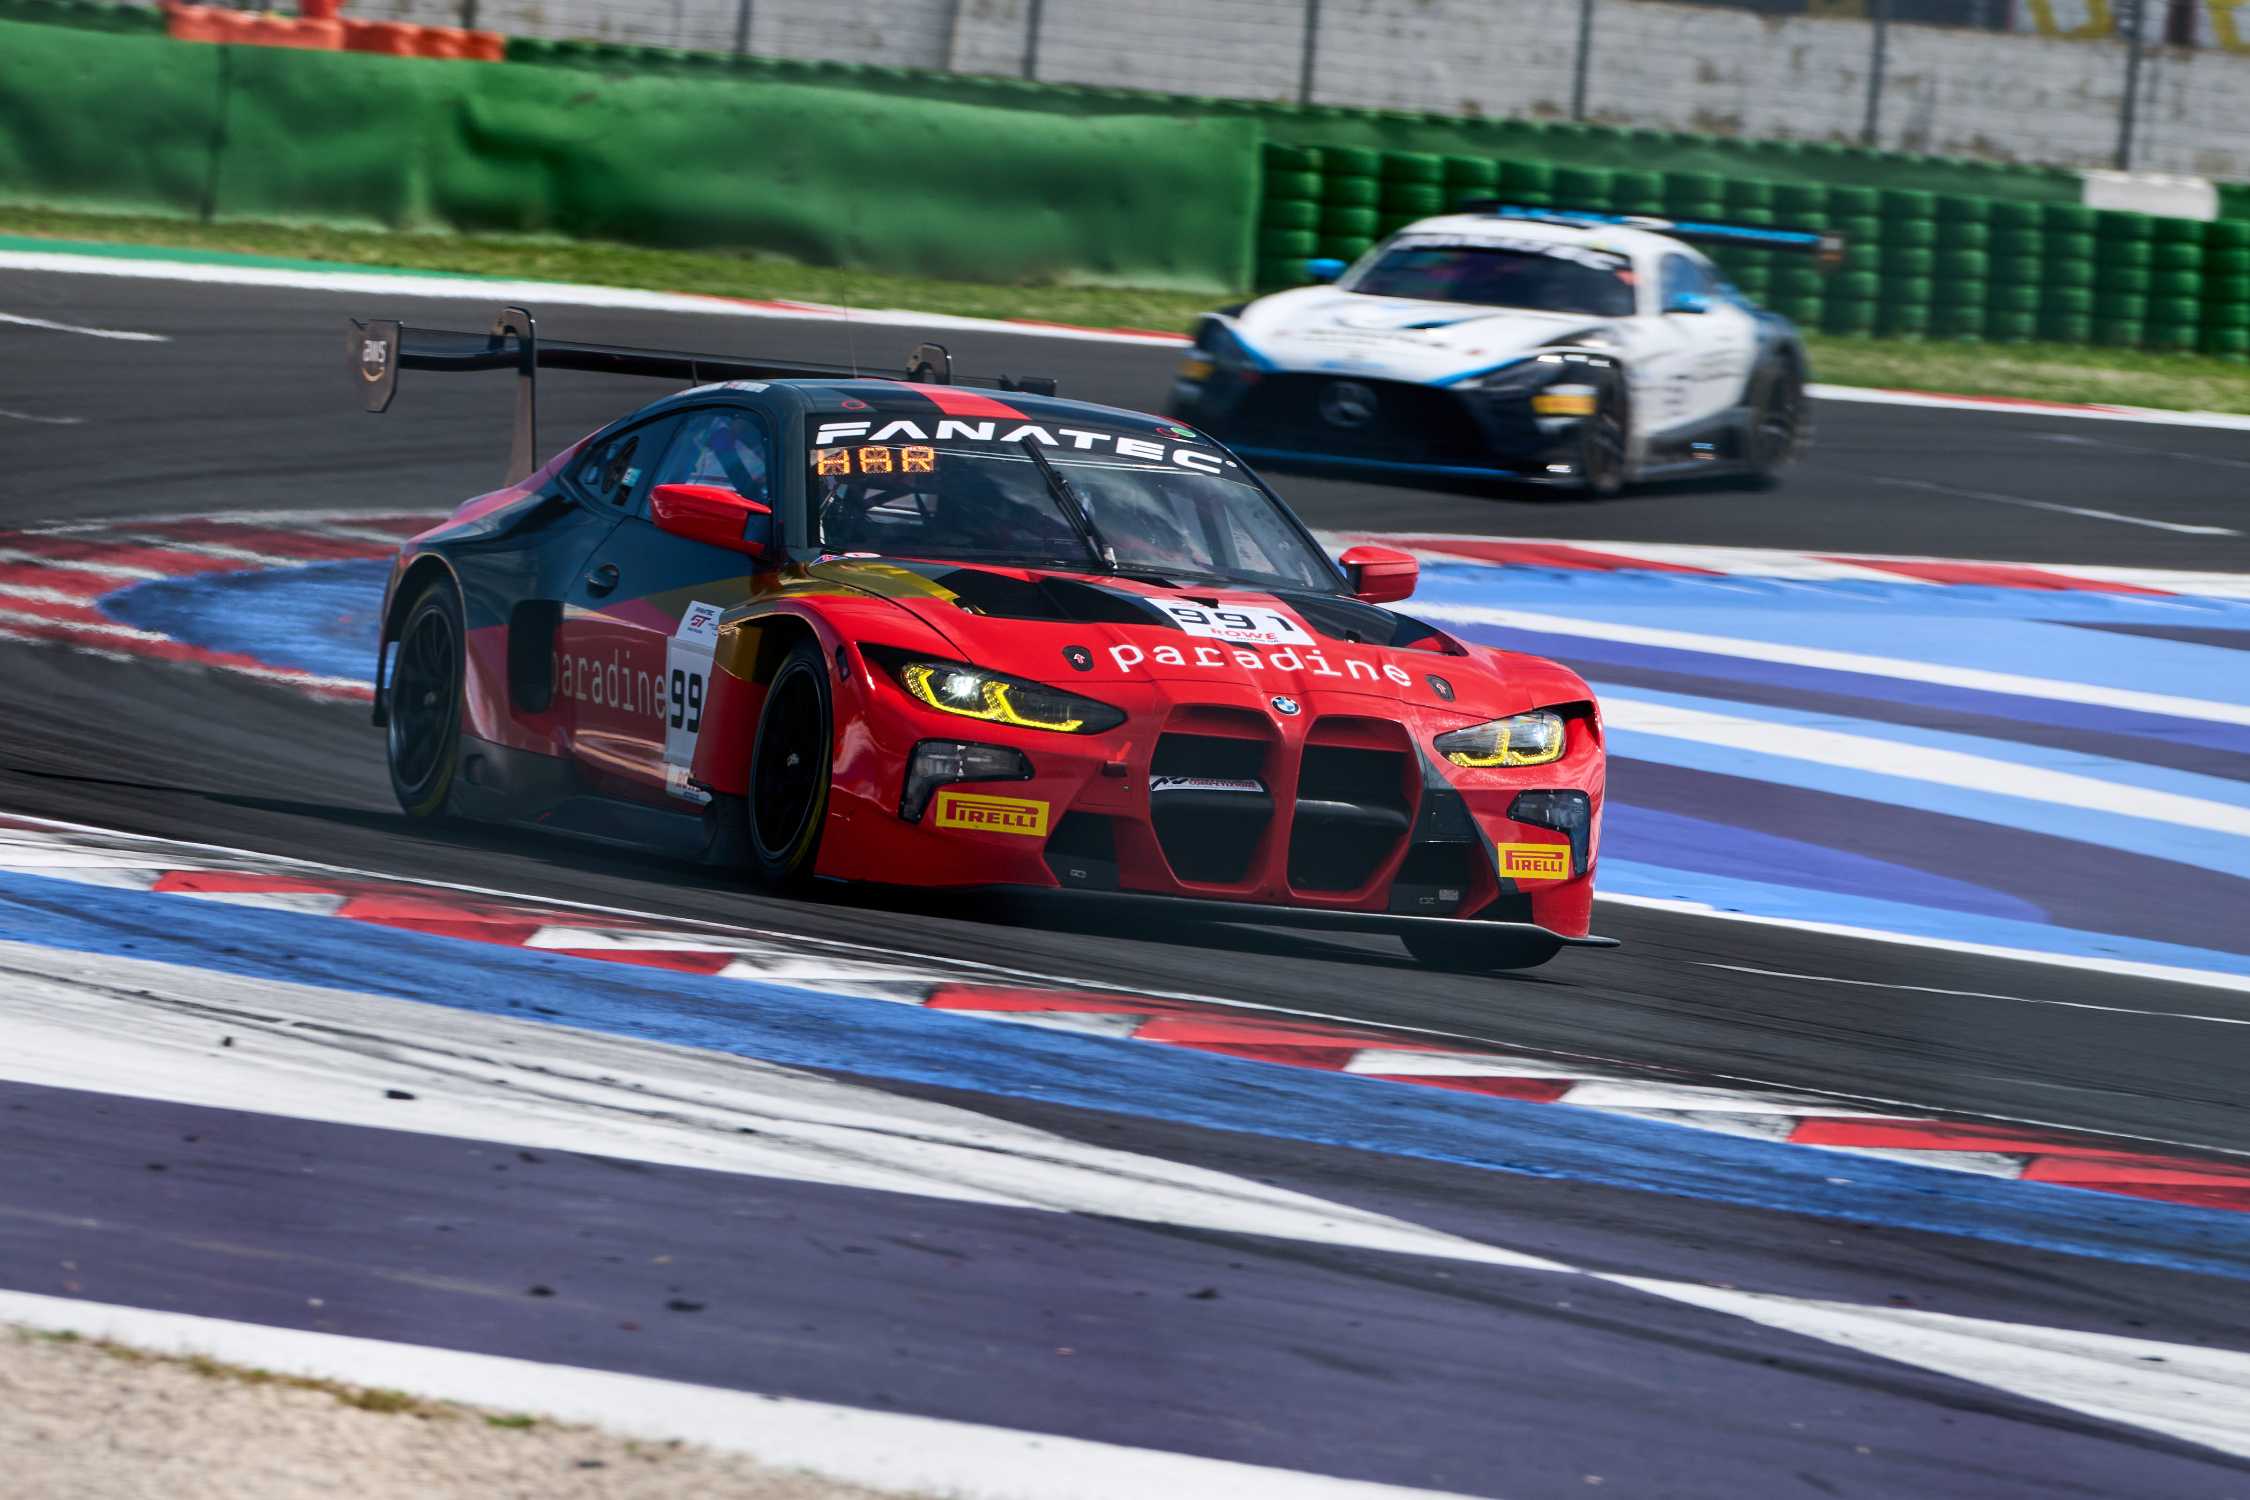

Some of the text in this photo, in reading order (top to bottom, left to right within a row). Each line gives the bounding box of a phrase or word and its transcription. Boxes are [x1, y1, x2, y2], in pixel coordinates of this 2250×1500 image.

[814, 420, 1224, 474] FANATEC
[1169, 608, 1294, 632] 991
[1109, 642, 1412, 688] paradine
[945, 798, 1040, 829] PIRELLI
[1504, 849, 1565, 873] PIRELLI
